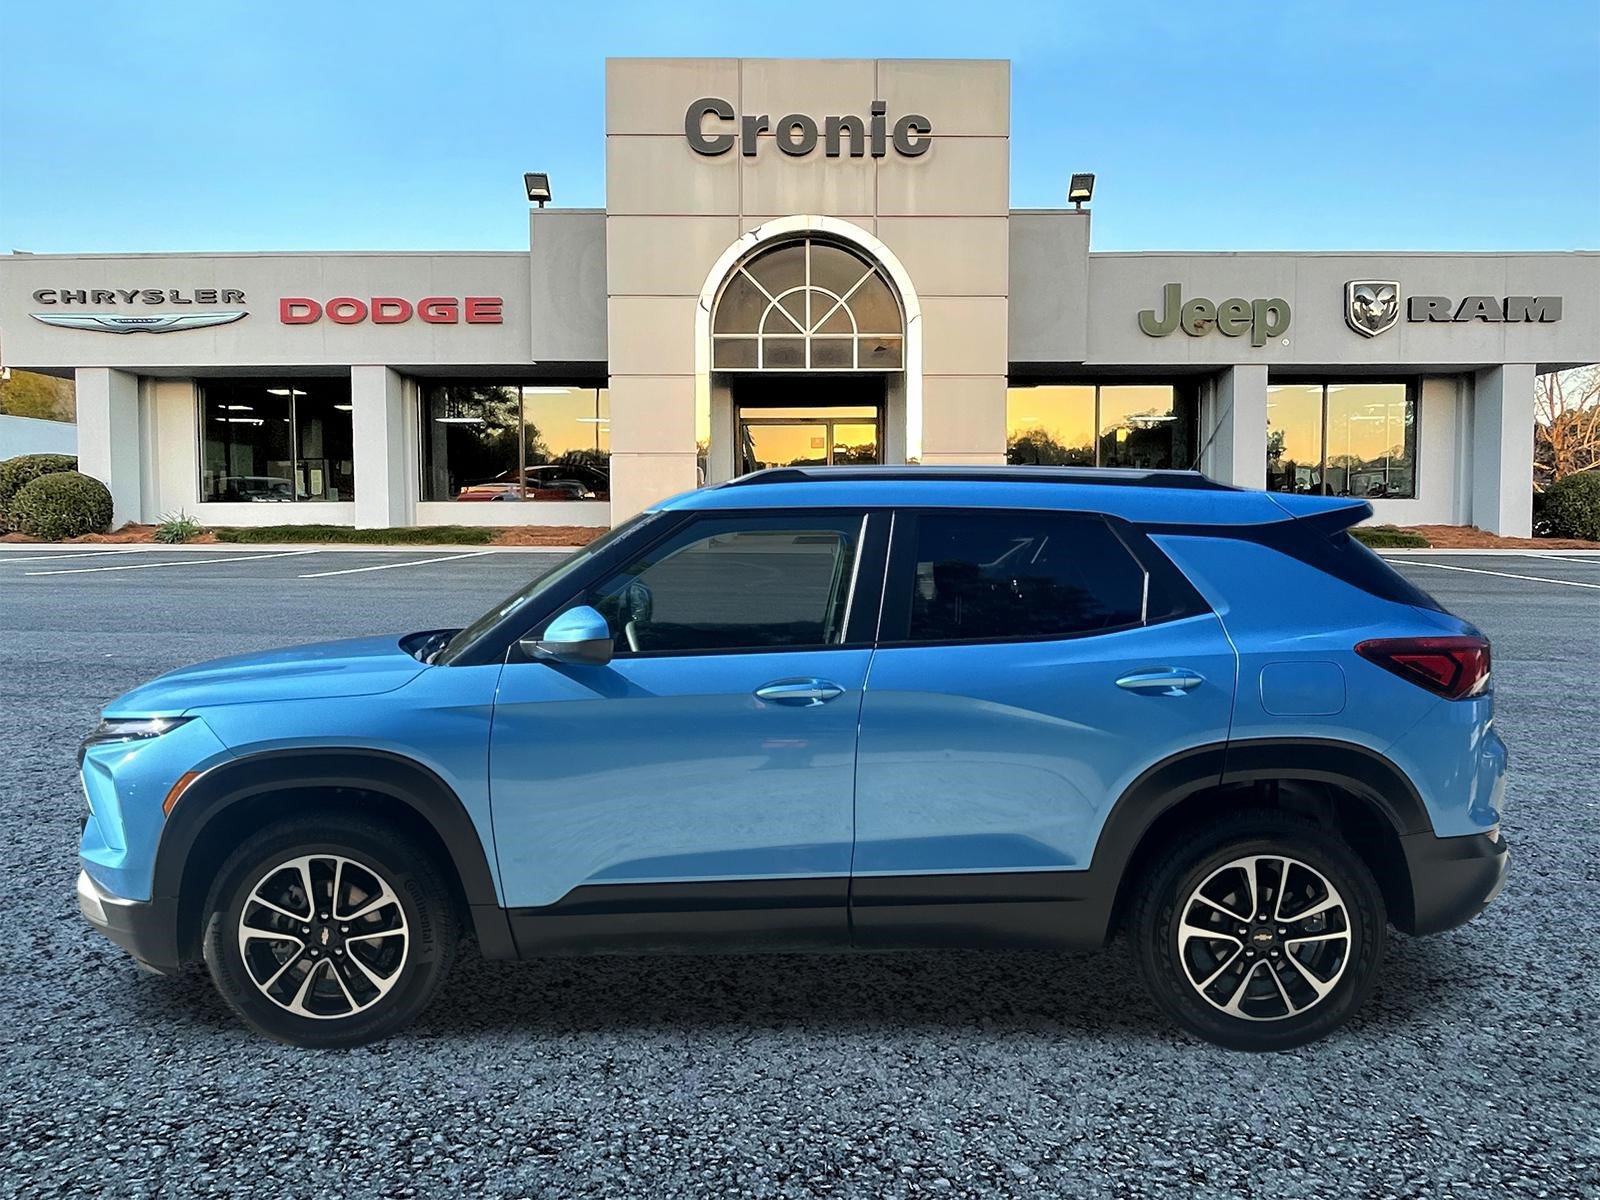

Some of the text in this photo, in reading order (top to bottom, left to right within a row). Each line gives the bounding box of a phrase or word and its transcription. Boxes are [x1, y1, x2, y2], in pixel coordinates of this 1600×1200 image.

[685, 97, 932, 158] Cronic
[32, 289, 246, 304] CHRYSLER
[1407, 296, 1562, 322] RAM
[280, 297, 503, 325] DODGE
[1138, 283, 1291, 347] Jeep
